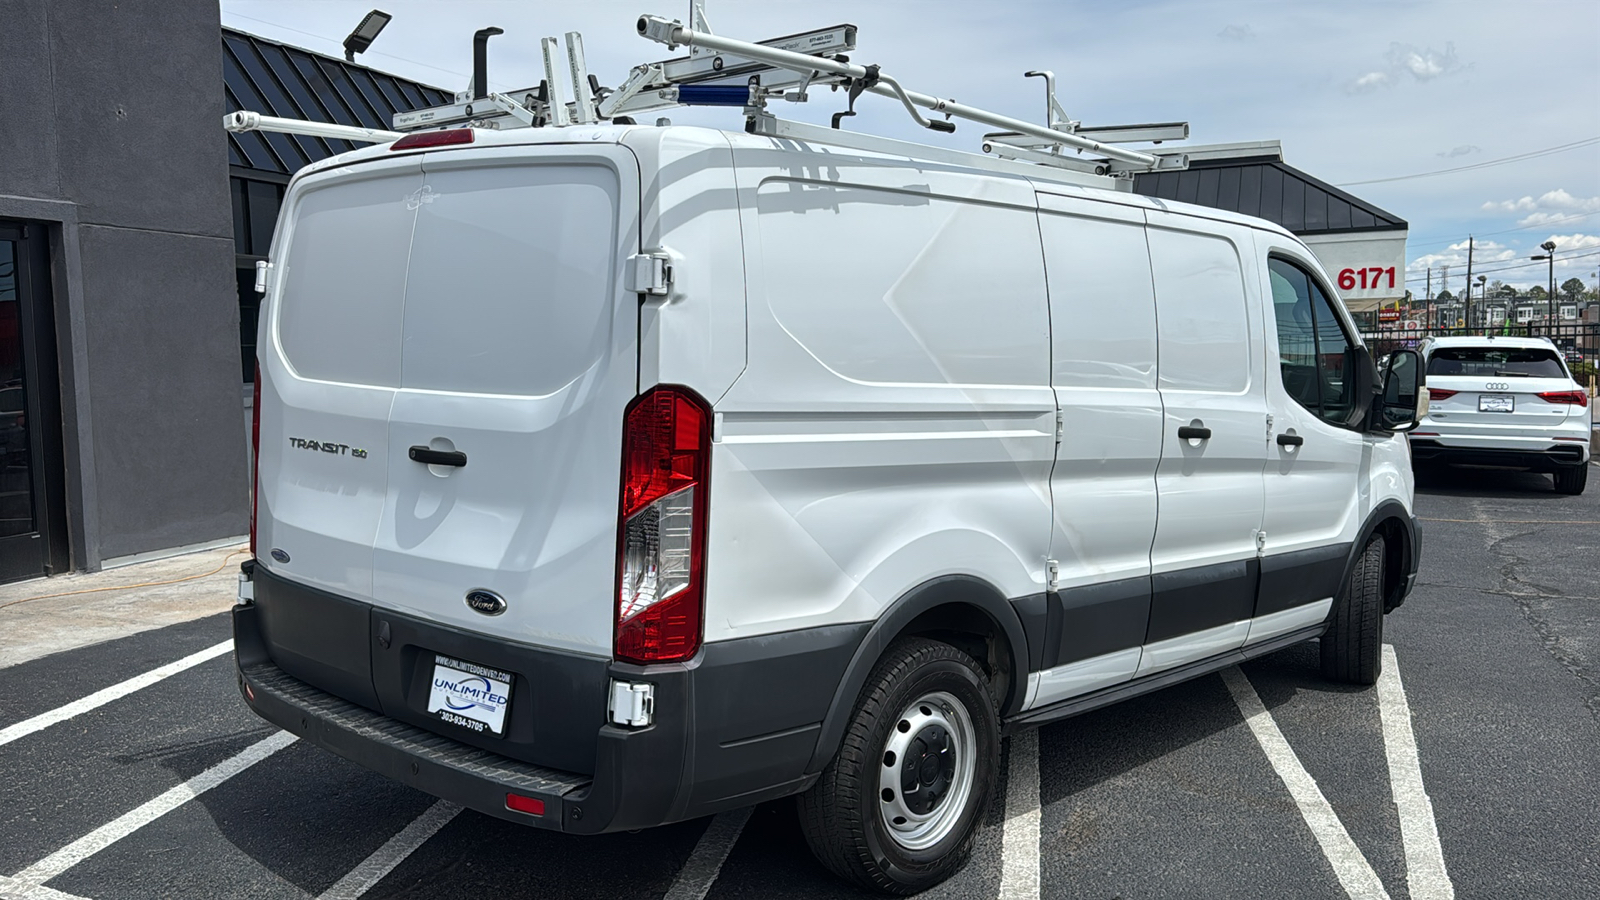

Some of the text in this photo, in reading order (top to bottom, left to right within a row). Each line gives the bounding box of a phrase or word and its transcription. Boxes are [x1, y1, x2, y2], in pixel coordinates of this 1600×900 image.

[1337, 266, 1395, 290] 6171
[289, 437, 368, 459] TRANSIT 150
[435, 655, 510, 683] WWW.UNLIMITEDDENVER.COM
[434, 678, 507, 705] UNLIMITED
[441, 711, 484, 732] 303-934-3705
